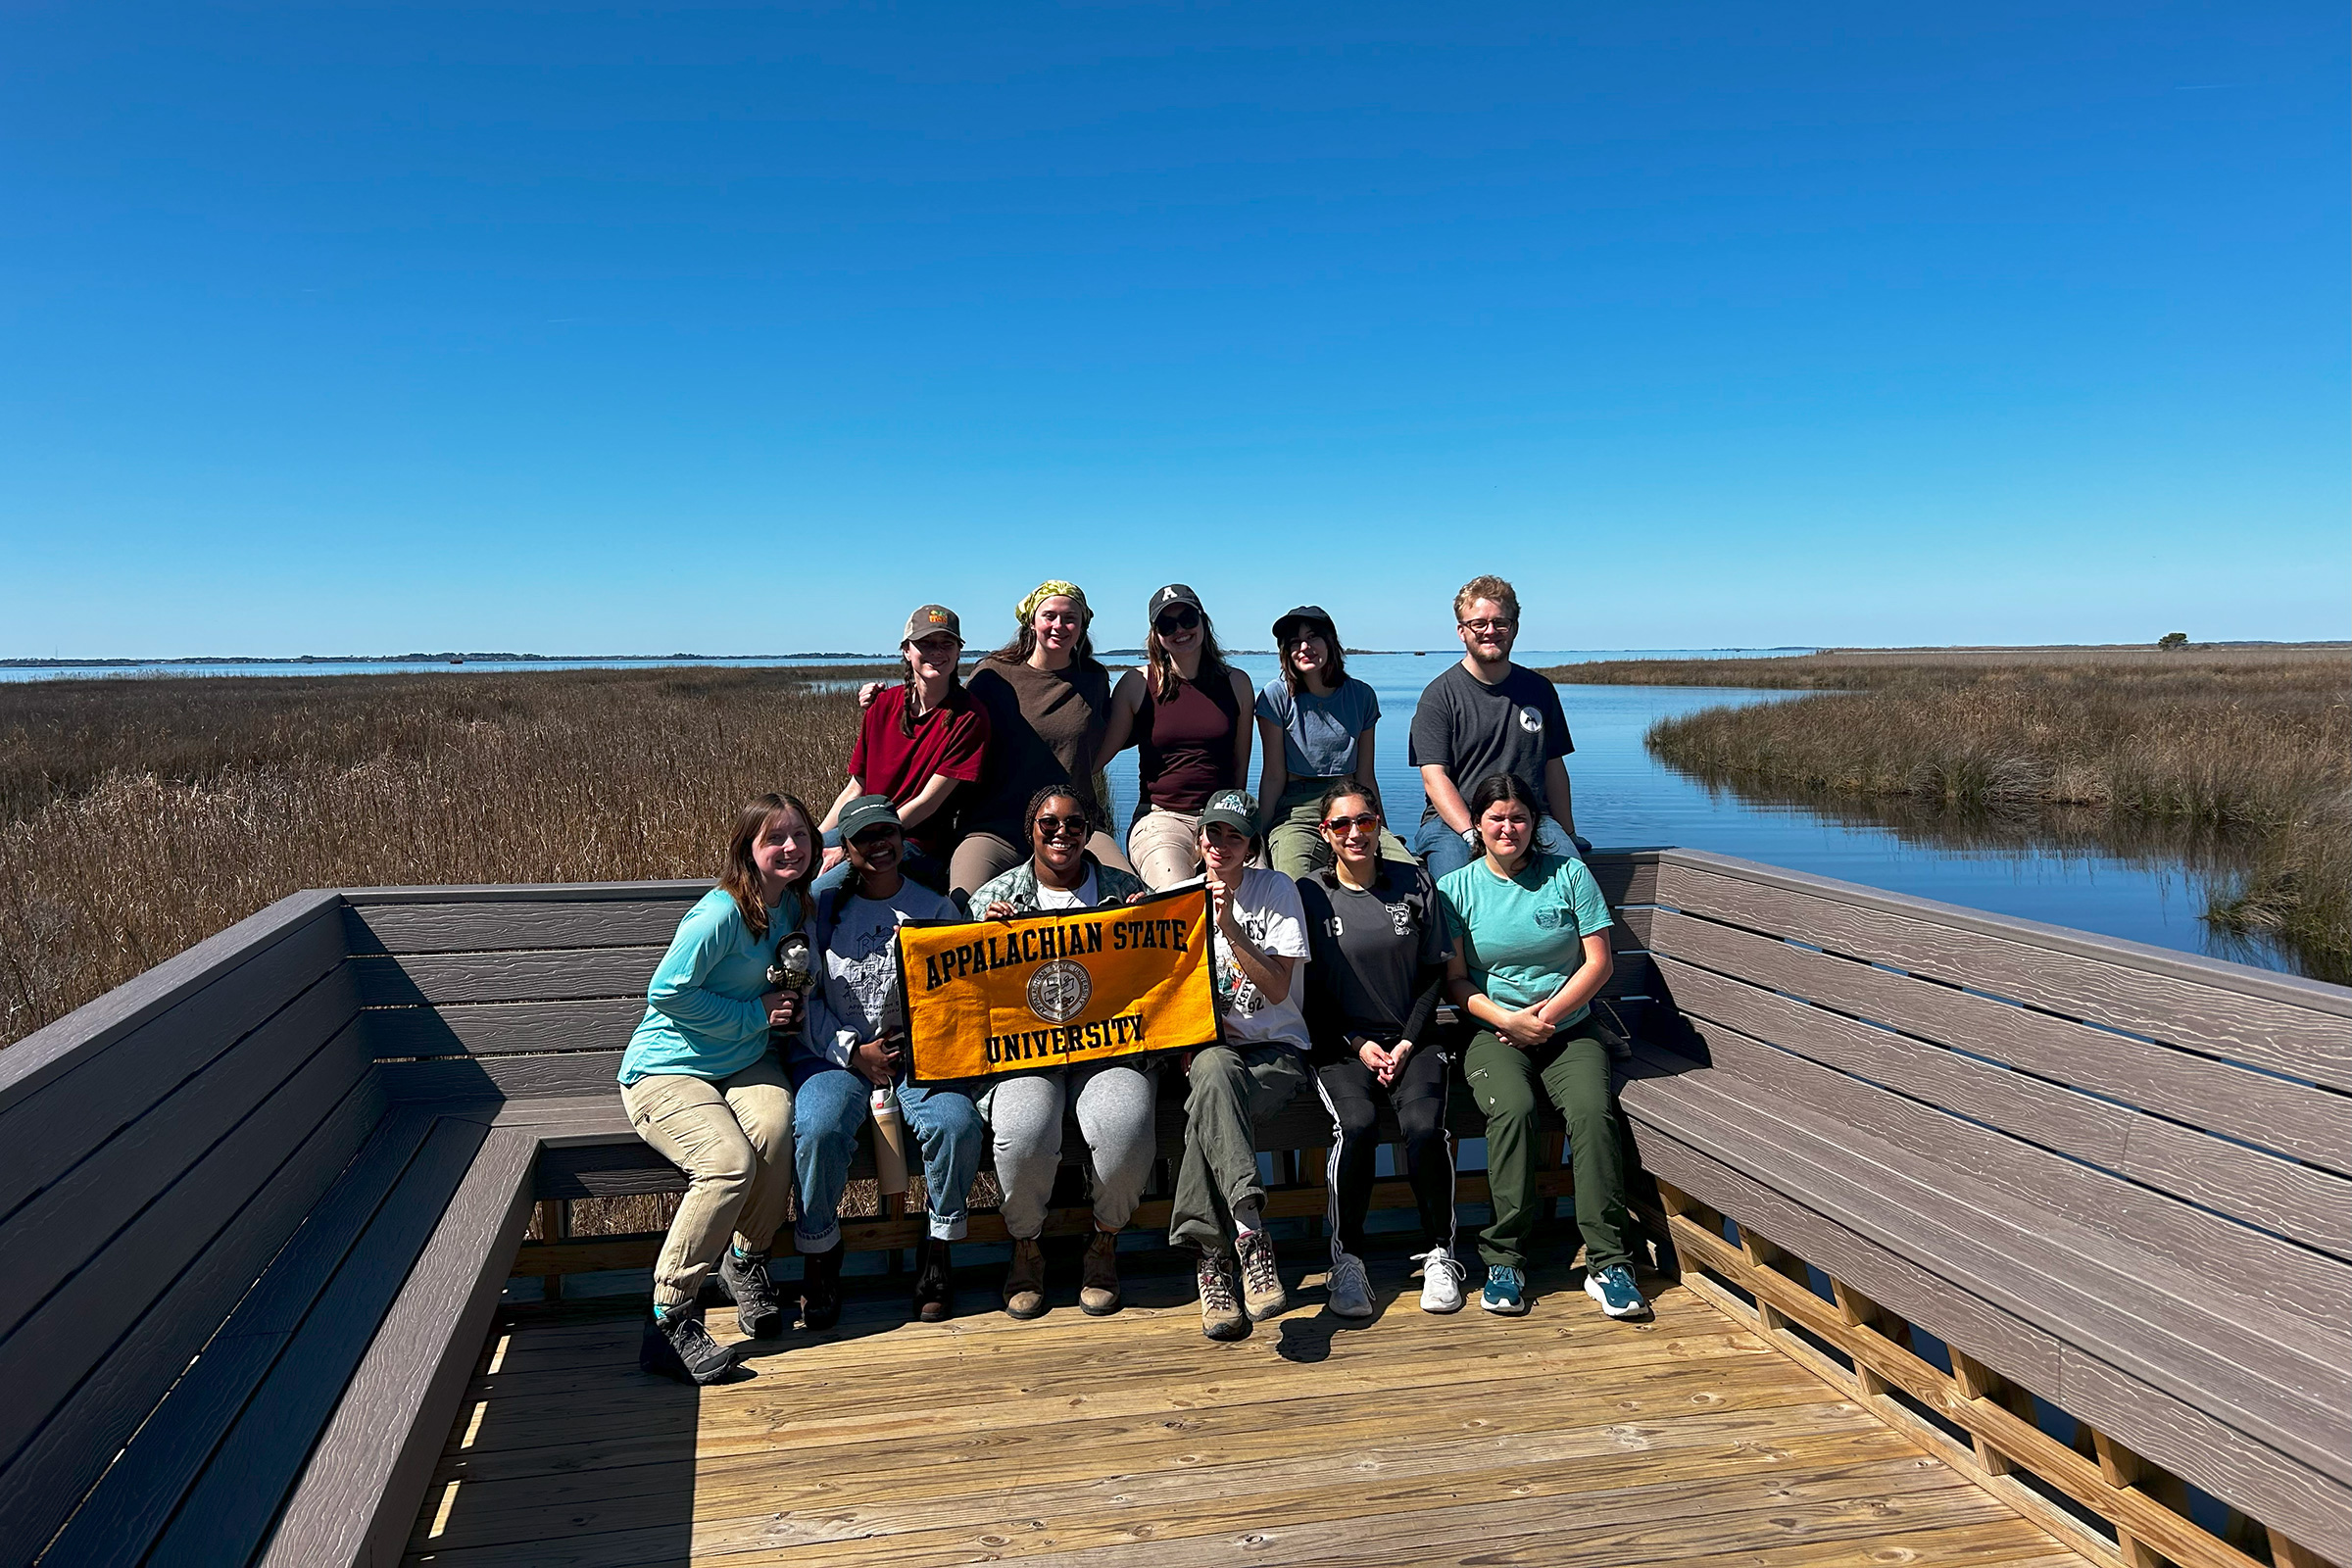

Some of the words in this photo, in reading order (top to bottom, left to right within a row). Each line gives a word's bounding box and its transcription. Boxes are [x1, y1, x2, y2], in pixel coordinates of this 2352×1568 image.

[1162, 587, 1178, 602] A
[1213, 803, 1247, 816] BELIKIN
[1323, 916, 1344, 937] 19
[926, 922, 1102, 992] APPALACHIAN
[1113, 919, 1188, 953] STATE
[1248, 997, 1264, 1013] 92
[985, 1014, 1145, 1063] UNIVERSITY
